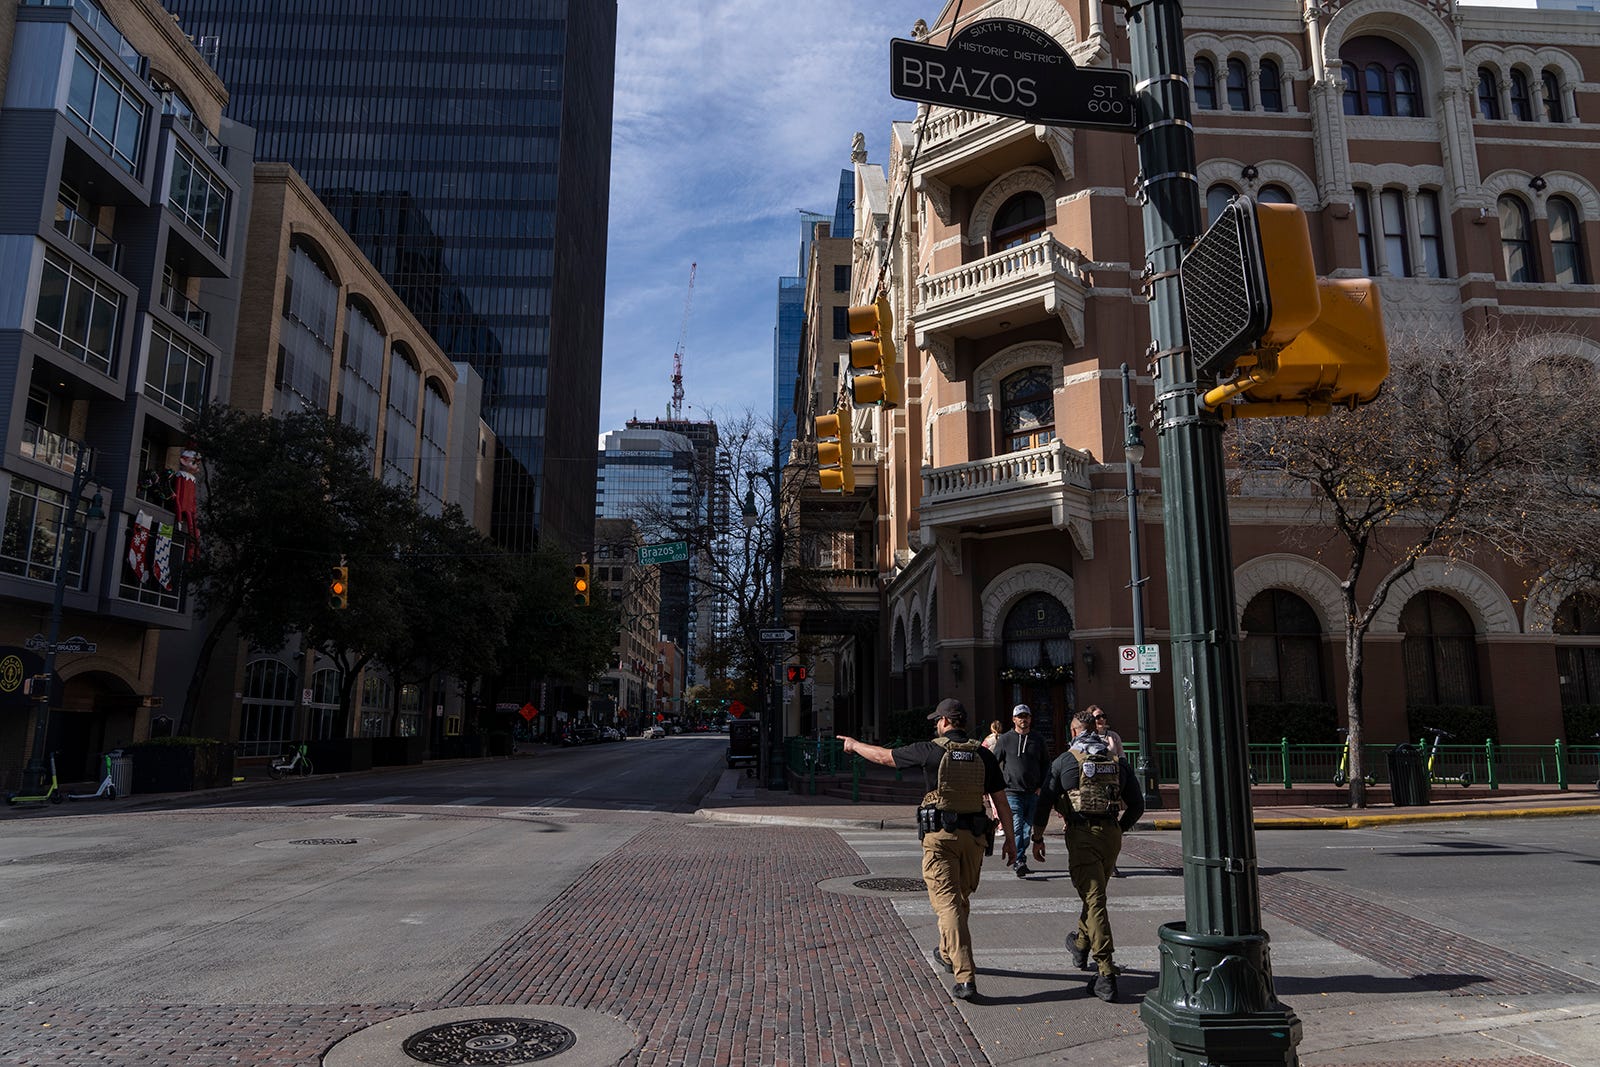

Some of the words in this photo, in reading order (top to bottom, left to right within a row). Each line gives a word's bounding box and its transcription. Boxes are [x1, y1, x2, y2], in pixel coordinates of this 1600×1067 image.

[970, 22, 1002, 38] SIXTH
[1007, 24, 1052, 49] STREET
[958, 41, 1009, 58] HISTORIC
[1014, 50, 1064, 65] DISTRICT
[902, 56, 1038, 107] BRAZOS
[1093, 84, 1118, 99] ST
[1087, 99, 1124, 114] 600
[641, 546, 674, 559] Brazos
[57, 644, 81, 652] BRAZOS
[952, 751, 973, 761] SECURITY
[1096, 764, 1116, 774] SECURITY
